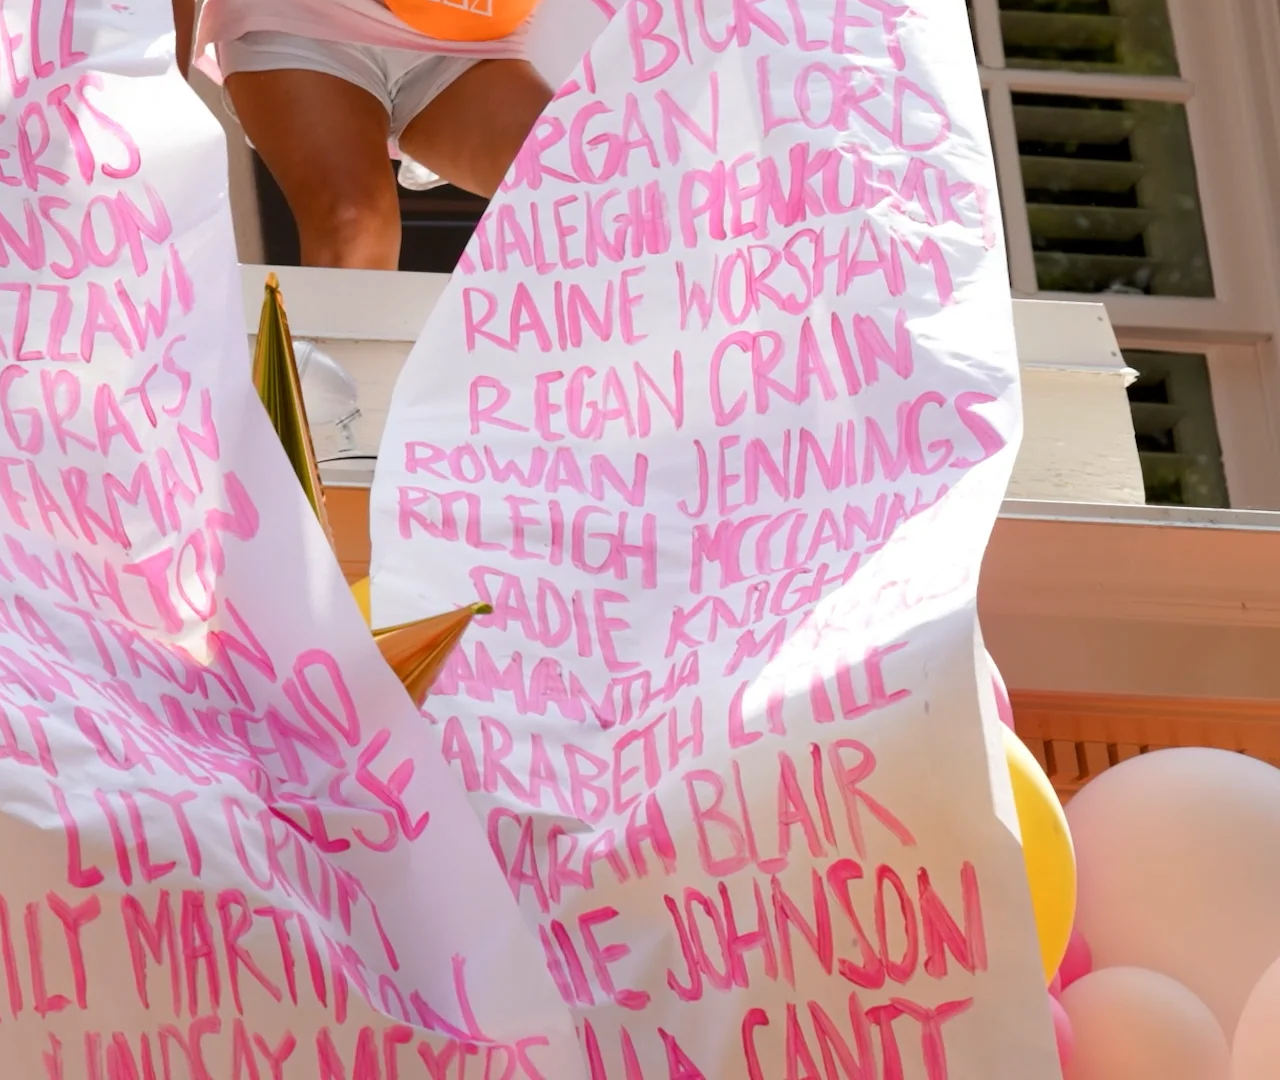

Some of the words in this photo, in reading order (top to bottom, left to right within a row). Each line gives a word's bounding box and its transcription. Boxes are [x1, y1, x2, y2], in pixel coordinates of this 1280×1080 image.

[757, 54, 952, 152] LORD
[461, 266, 647, 353] RAINE
[676, 219, 956, 330] WORSHAM
[469, 350, 684, 442] REGAN
[709, 308, 914, 426] CRAIN
[404, 441, 649, 506] ROWAN
[676, 391, 1006, 518] JENNINGS
[3, 471, 260, 635] WALTON
[452, 565, 642, 673] SADIE
[664, 545, 887, 659] KNIGH
[420, 639, 700, 732] AMANTHA
[422, 696, 705, 827] ARABETH
[681, 739, 918, 878] BLAIR
[47, 779, 198, 888] LILY
[663, 857, 989, 1003] JOHNSON
